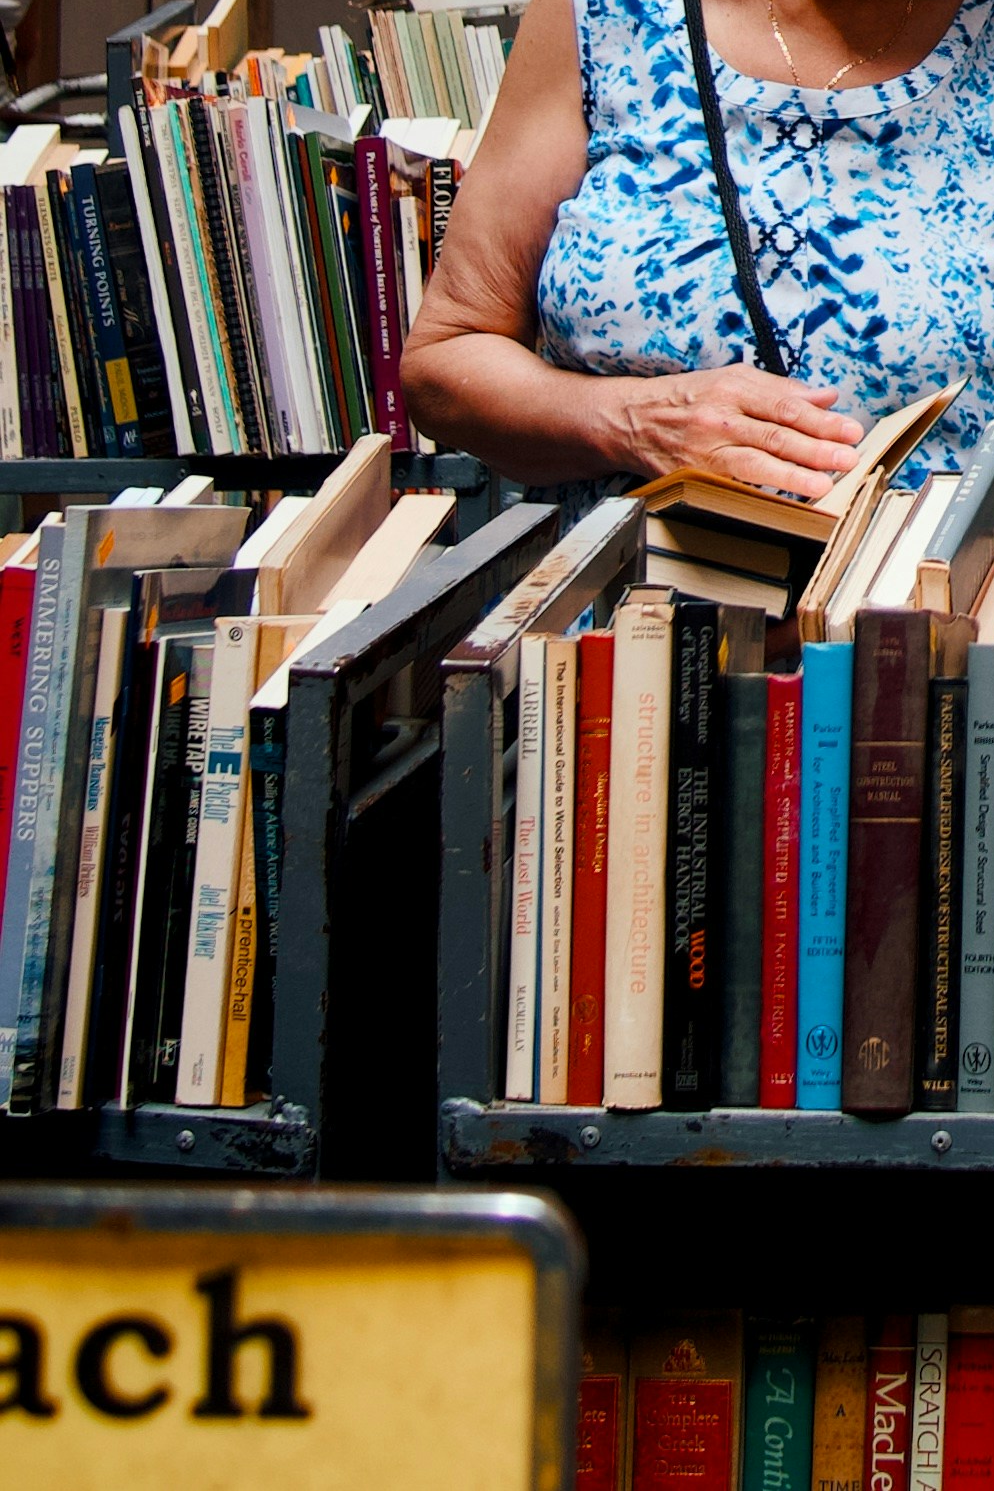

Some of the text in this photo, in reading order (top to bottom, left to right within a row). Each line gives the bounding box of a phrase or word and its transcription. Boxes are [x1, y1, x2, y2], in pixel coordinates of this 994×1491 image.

[234, 119, 246, 149] Mario
[82, 195, 117, 328] TURNING POINTS
[955, 464, 982, 503] TROUT
[17, 558, 62, 842] SIMMERING SUPPERS
[184, 698, 210, 774] WIRETAP
[210, 725, 245, 751] The
[522, 679, 540, 760] JARRELL
[553, 660, 567, 899] The International Guide to Wood Selection
[515, 816, 536, 936] The Lost World
[628, 692, 658, 995] structure in architecture
[675, 767, 692, 954] ENERGY HANDBOOK
[690, 767, 708, 990] THE INDUSTRIAL WOOD
[194, 884, 229, 961] Joel Makower
[231, 919, 254, 1022] prentice-hall
[515, 985, 528, 1053] MACMILLAN
[916, 1347, 942, 1467] SCRATCH
